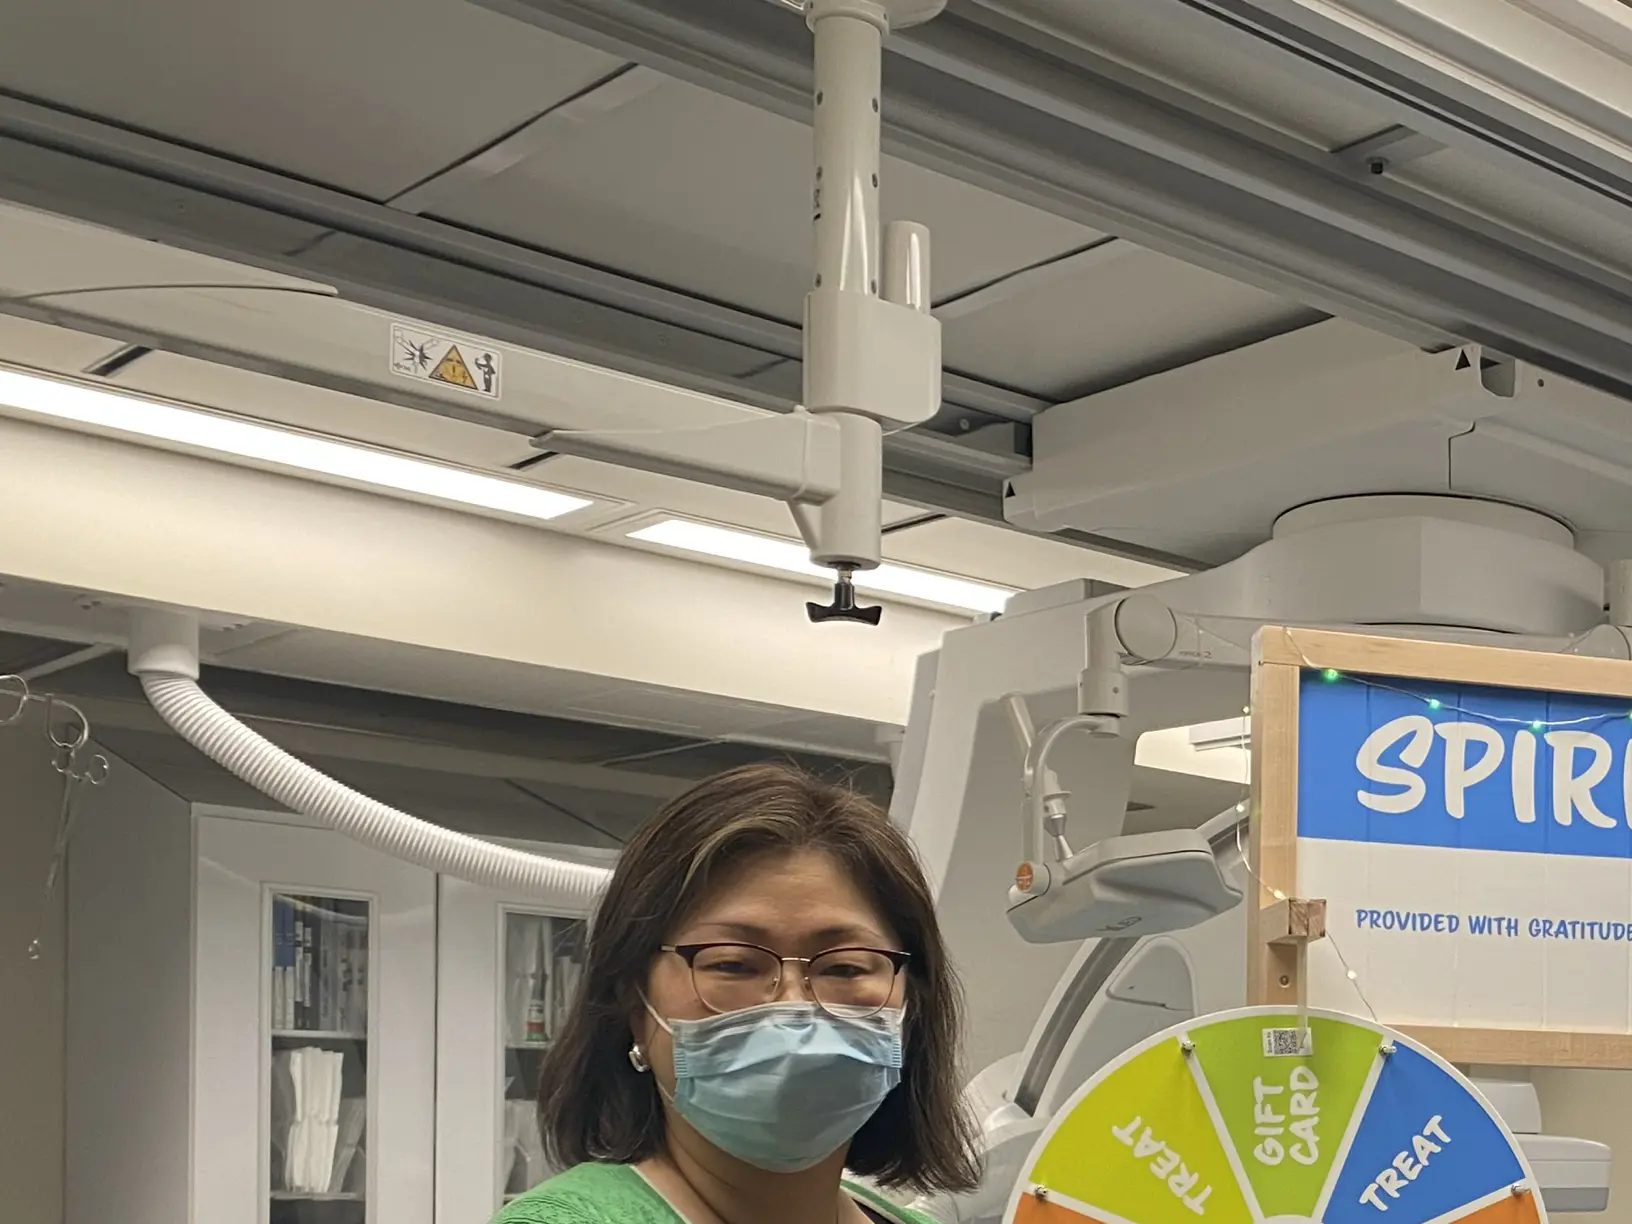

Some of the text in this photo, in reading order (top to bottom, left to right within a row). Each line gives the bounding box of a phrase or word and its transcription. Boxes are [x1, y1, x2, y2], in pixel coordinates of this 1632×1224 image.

[1356, 909, 1460, 934] PROVIDED
[1468, 915, 1519, 938] WITH
[1253, 1076, 1284, 1166] GIFT
[1289, 1065, 1320, 1165] CARD
[1359, 1114, 1452, 1212] TREAT
[1112, 1117, 1213, 1215] TREAT
